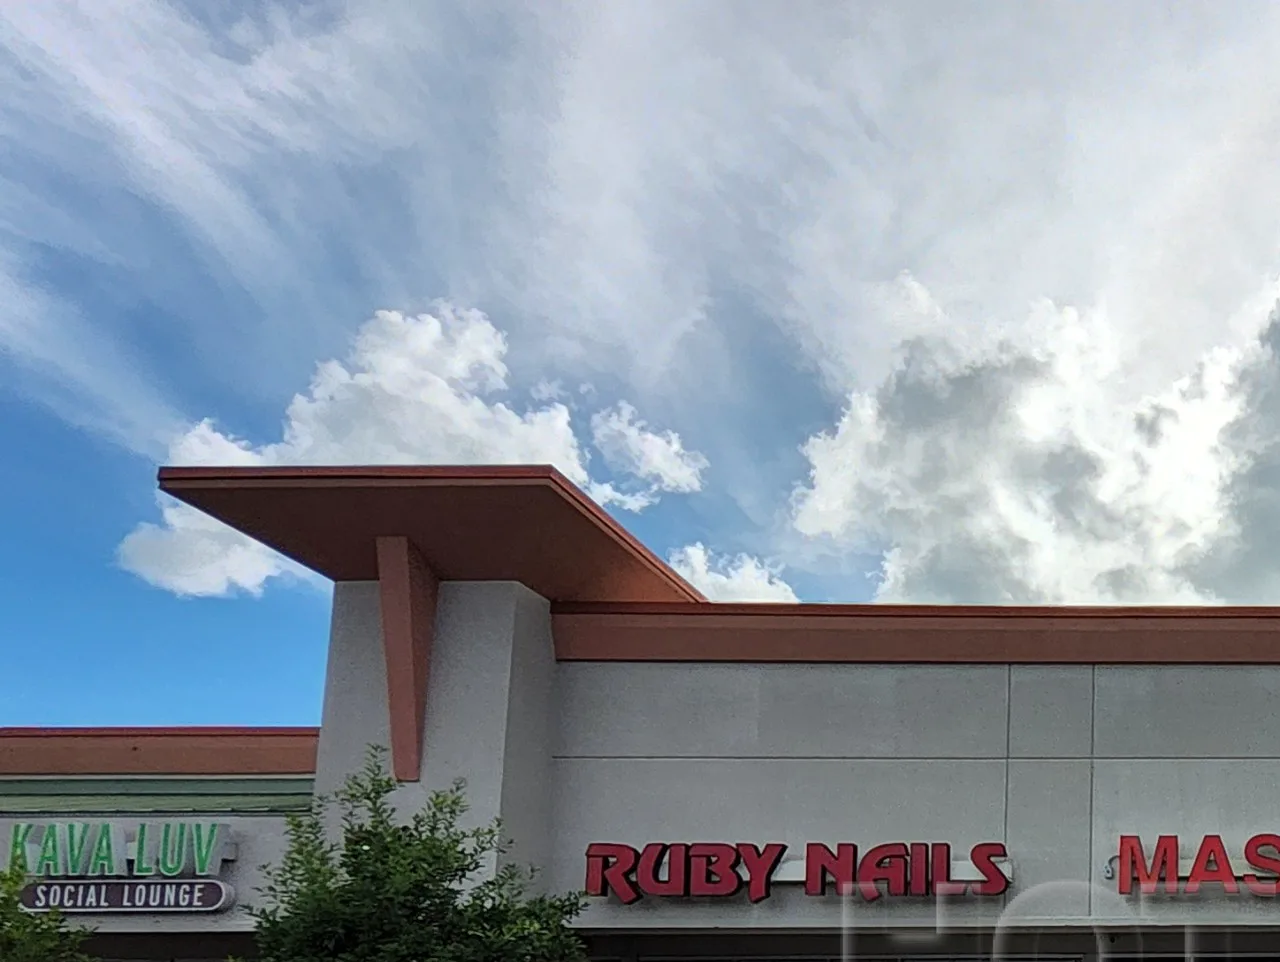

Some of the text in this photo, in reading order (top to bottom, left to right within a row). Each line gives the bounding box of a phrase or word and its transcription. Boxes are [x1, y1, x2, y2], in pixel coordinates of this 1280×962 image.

[9, 823, 217, 876] KAVA LUV
[585, 842, 1010, 904] RUBY NAILS
[35, 884, 205, 907] SOCIAL LOUNGE
